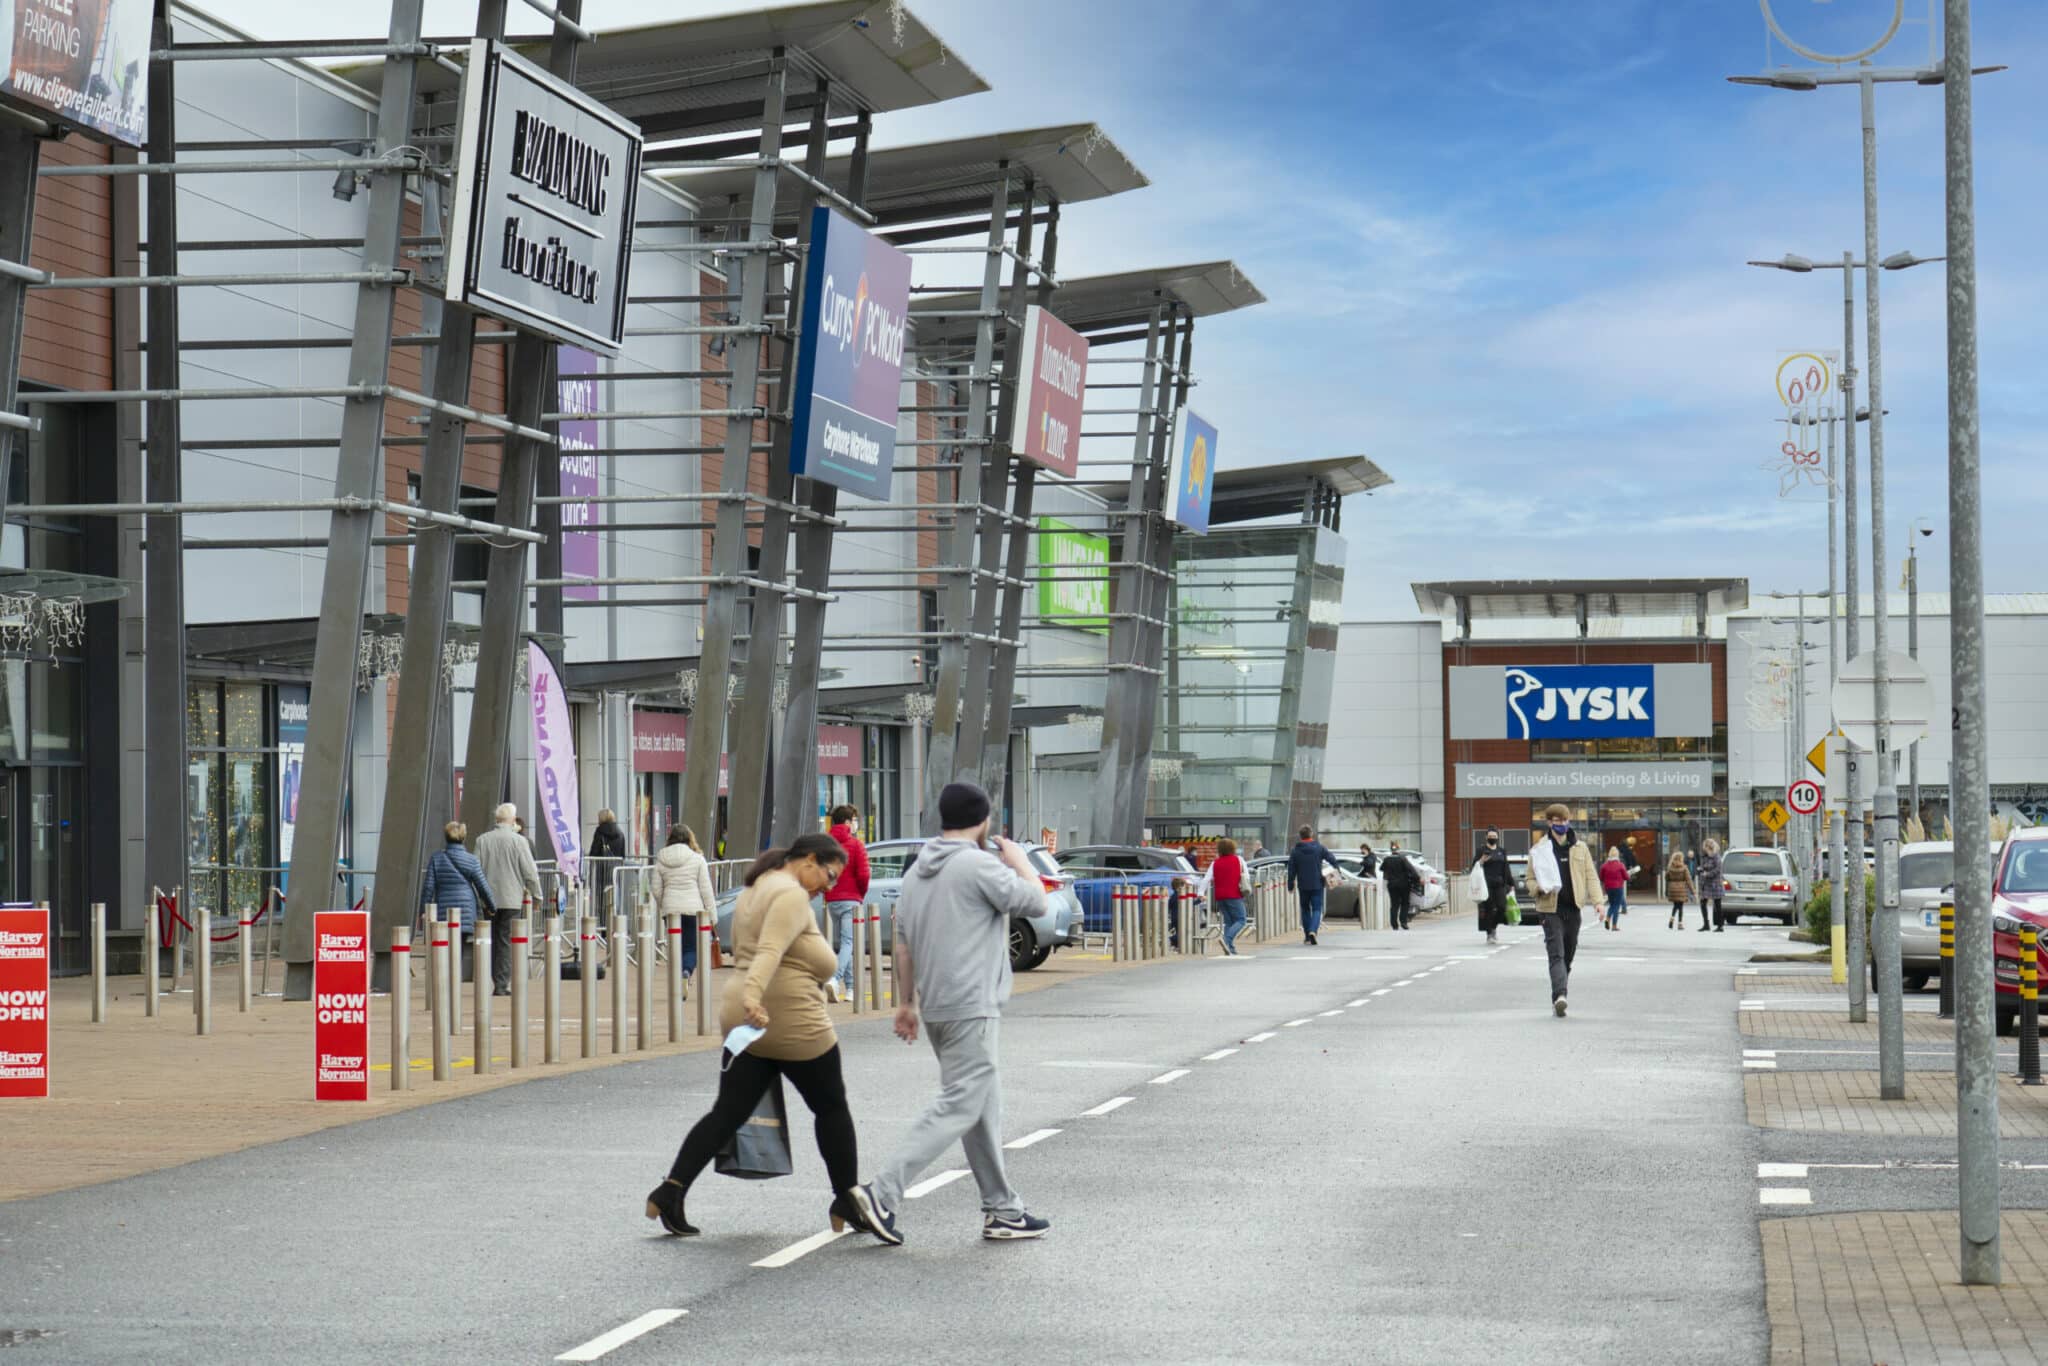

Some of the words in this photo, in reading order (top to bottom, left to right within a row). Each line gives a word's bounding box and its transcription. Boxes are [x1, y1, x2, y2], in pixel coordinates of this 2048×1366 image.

[23, 8, 80, 58] PARKING
[13, 69, 145, 134] www.sligoretailpark.com
[502, 216, 600, 305] furniture
[822, 274, 854, 352] Currys
[823, 418, 850, 457] Carphone
[849, 429, 880, 466] Warehouse
[1535, 687, 1649, 721] JYSK
[280, 699, 308, 725] Carphone
[1466, 771, 1567, 787] Scandinavian
[1569, 771, 1636, 788] Sleeping
[1639, 772, 1651, 785] &
[1654, 771, 1700, 788] Living
[1795, 788, 1815, 801] 10
[0, 931, 43, 946] Harvey
[320, 934, 363, 949] Harvey
[318, 948, 364, 960] Norman
[0, 990, 46, 1005] NOW
[318, 993, 365, 1008] NOW
[0, 1007, 45, 1020] OPEN
[318, 1010, 364, 1024] OPEN
[320, 1054, 363, 1069] Harvey
[319, 1068, 365, 1081] Norman
